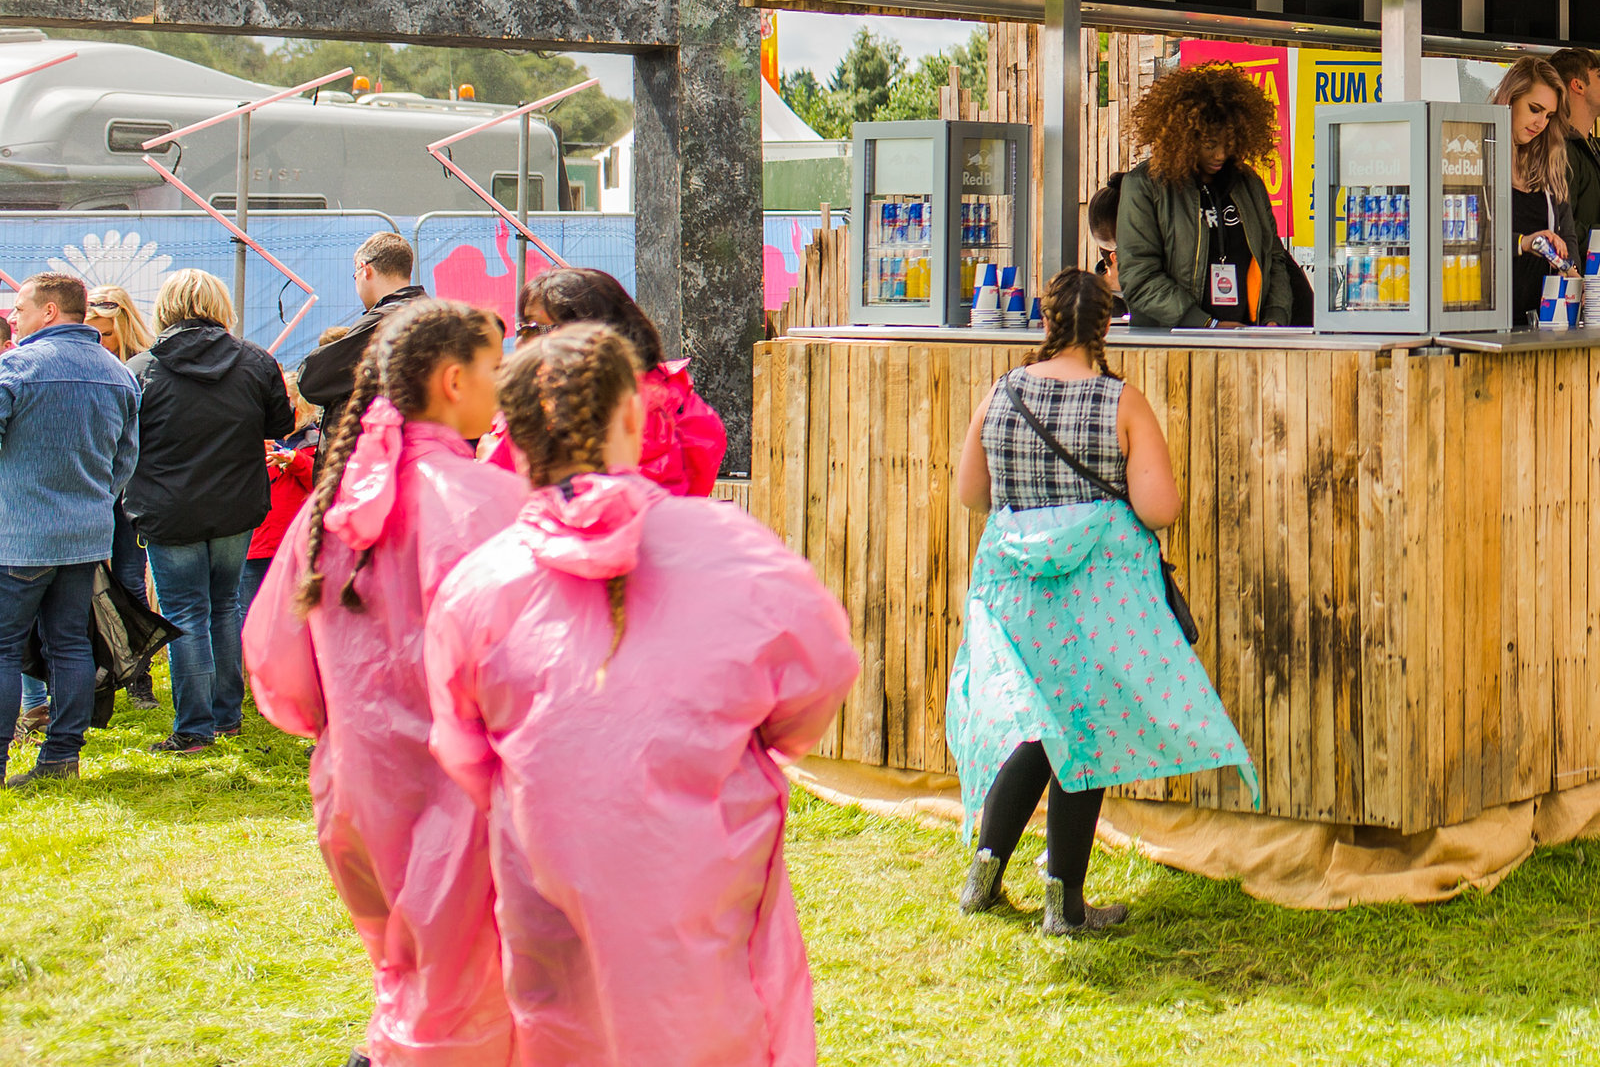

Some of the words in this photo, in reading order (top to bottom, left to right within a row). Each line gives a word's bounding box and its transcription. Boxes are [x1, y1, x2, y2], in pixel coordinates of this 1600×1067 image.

[1315, 71, 1367, 103] RUM
[252, 167, 303, 181] EIST
[1349, 159, 1374, 175] Red
[1376, 159, 1400, 176] Bull
[1442, 159, 1461, 176] Red
[1463, 158, 1483, 176] Bull
[962, 171, 984, 185] Red
